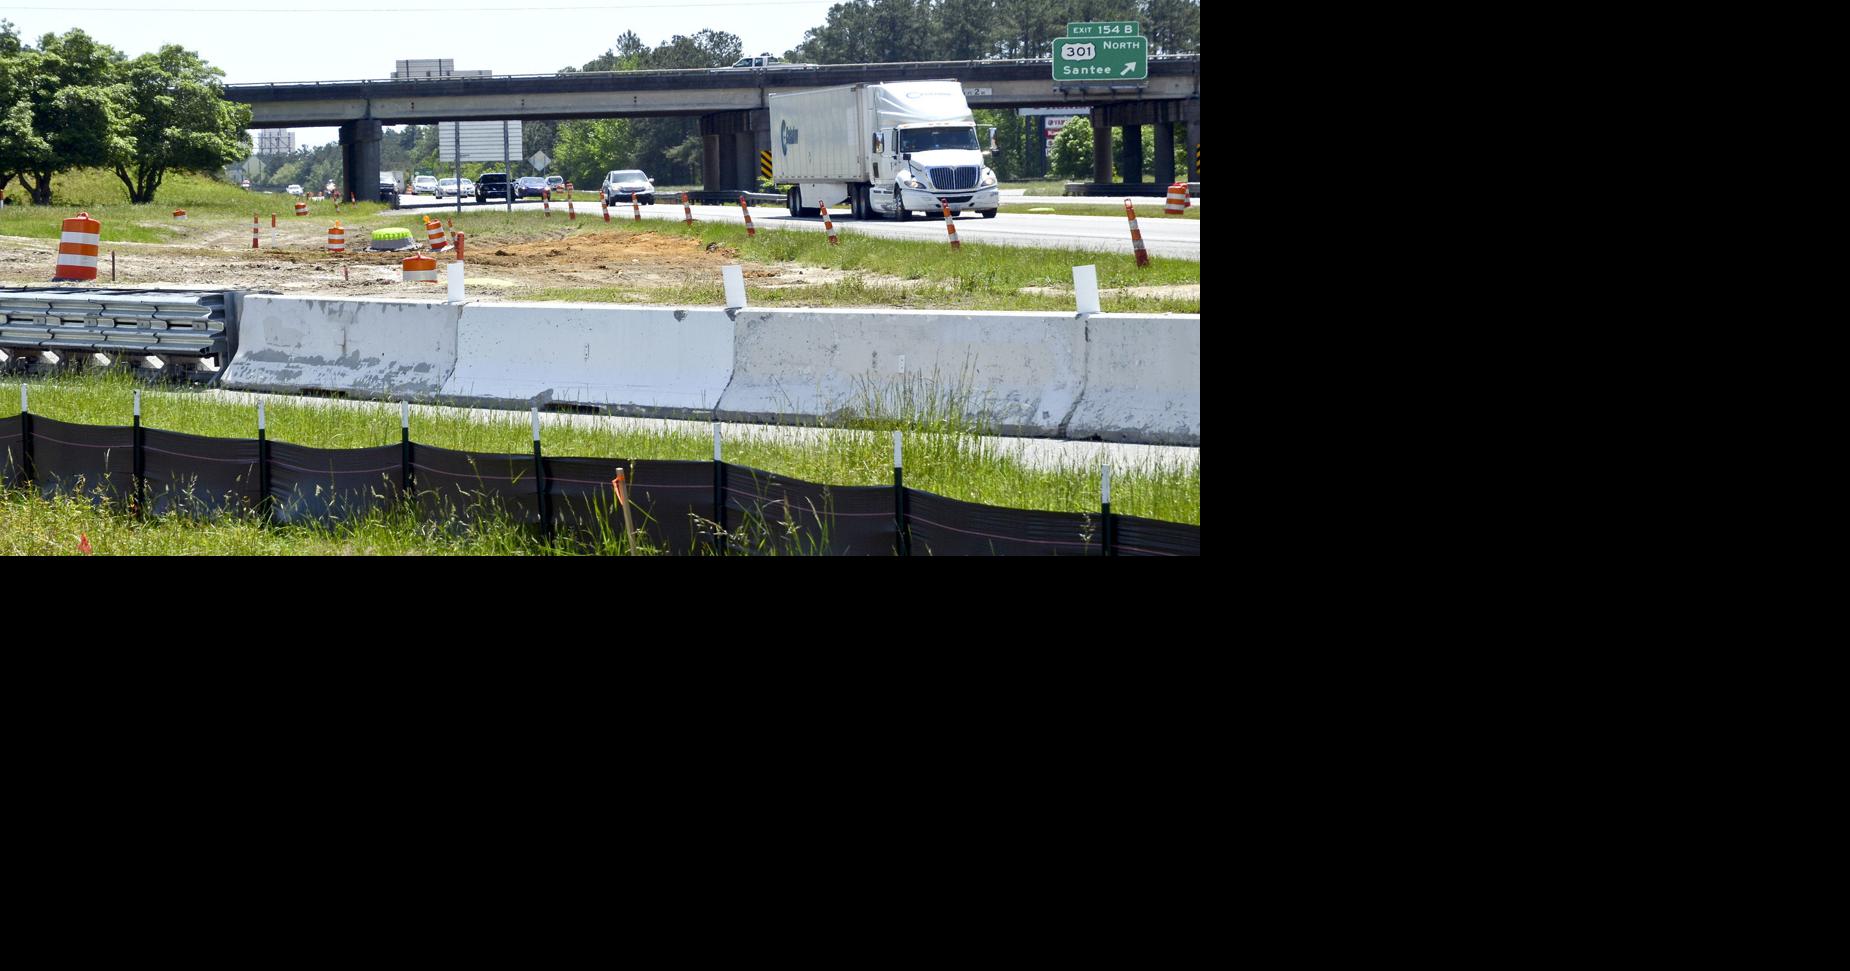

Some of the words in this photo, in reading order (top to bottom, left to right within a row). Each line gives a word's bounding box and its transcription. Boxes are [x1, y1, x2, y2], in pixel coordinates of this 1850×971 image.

[1073, 26, 1093, 34] EXIT
[1098, 25, 1120, 34] 154
[1124, 24, 1133, 34] B
[1103, 41, 1140, 50] NORTH
[1066, 46, 1091, 57] 301
[1063, 65, 1112, 75] Santee
